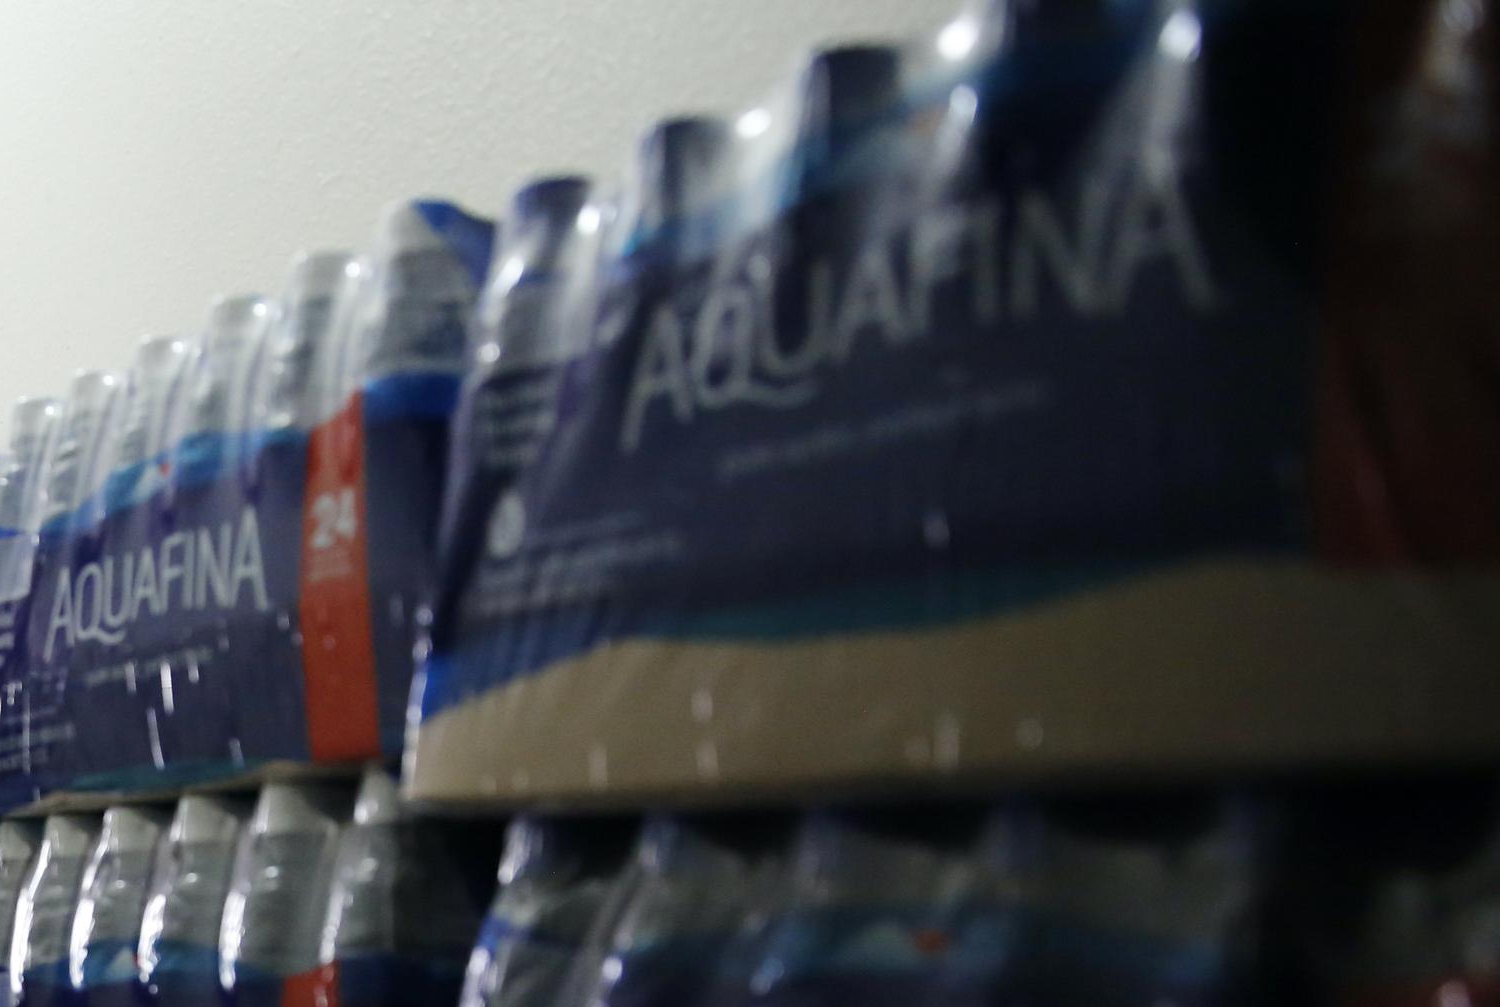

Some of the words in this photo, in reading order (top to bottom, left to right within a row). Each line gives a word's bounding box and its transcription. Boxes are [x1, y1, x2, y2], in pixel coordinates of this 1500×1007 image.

[616, 170, 1222, 453] AQUAFINA
[43, 506, 268, 662] AQUAFINA
[309, 488, 357, 549] 24
